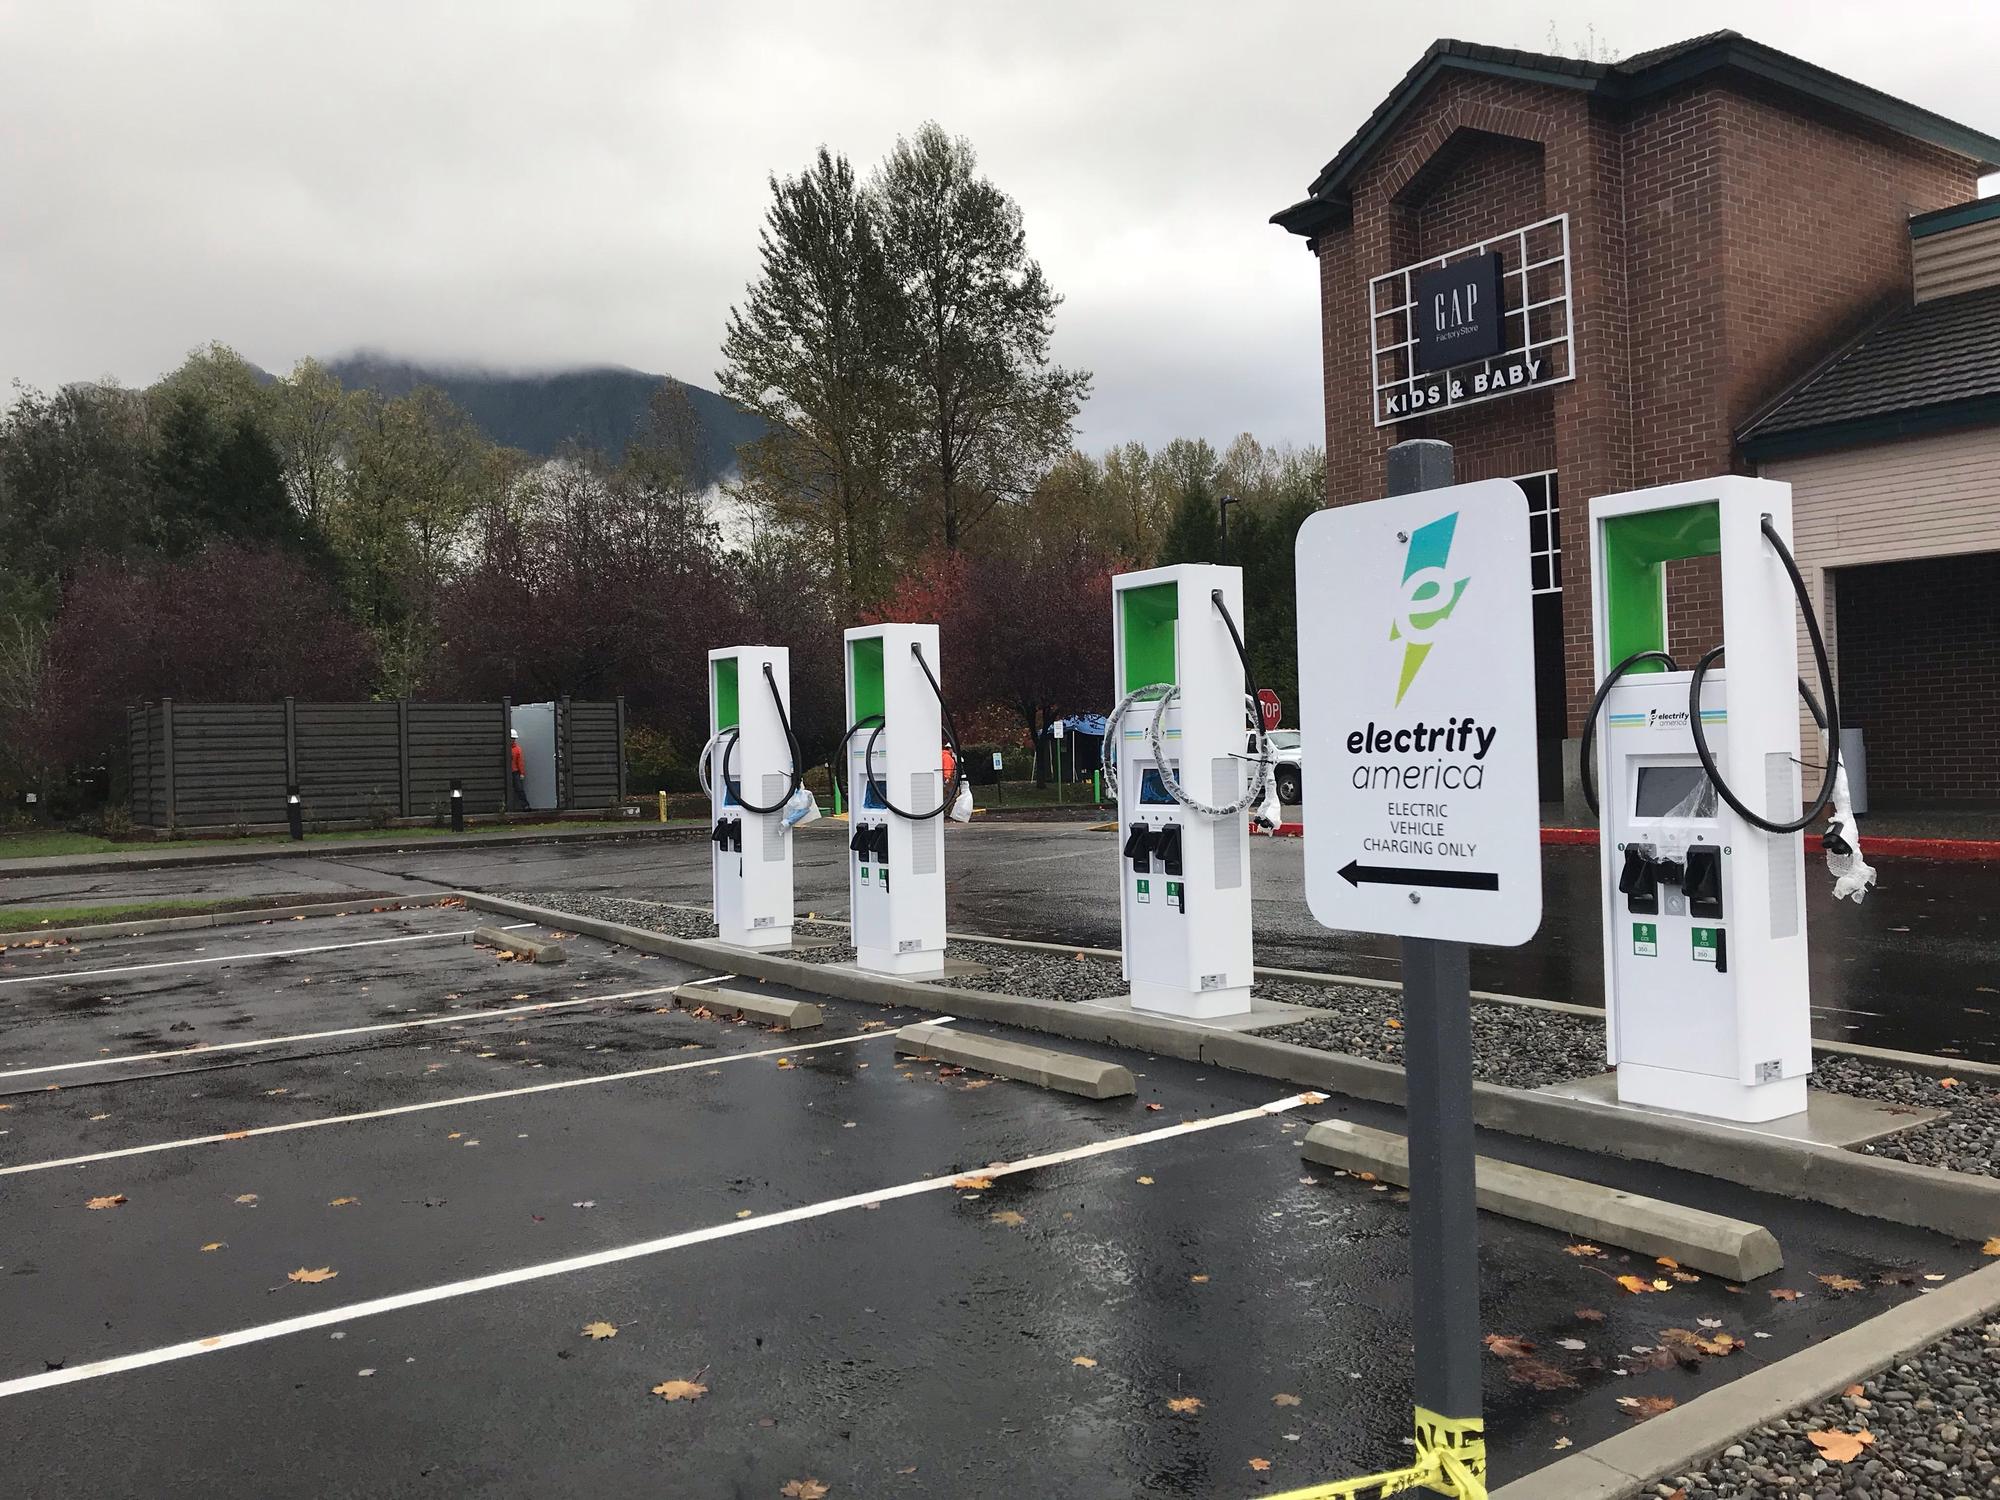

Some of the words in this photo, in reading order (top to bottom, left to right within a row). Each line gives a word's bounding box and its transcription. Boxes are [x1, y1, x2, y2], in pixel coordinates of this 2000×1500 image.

[1434, 283, 1478, 331] GAP
[1386, 385, 1441, 414] KIDS
[1450, 380, 1464, 399] &
[1474, 361, 1541, 392] BABY
[1658, 711, 1690, 721] electrify
[1346, 717, 1497, 760] electrify
[1352, 758, 1485, 790] america
[1388, 803, 1448, 818] ELECTRIC
[1390, 821, 1445, 836] VEHICLE
[1363, 838, 1433, 855] CHARGING
[1437, 842, 1477, 857] ONLY
